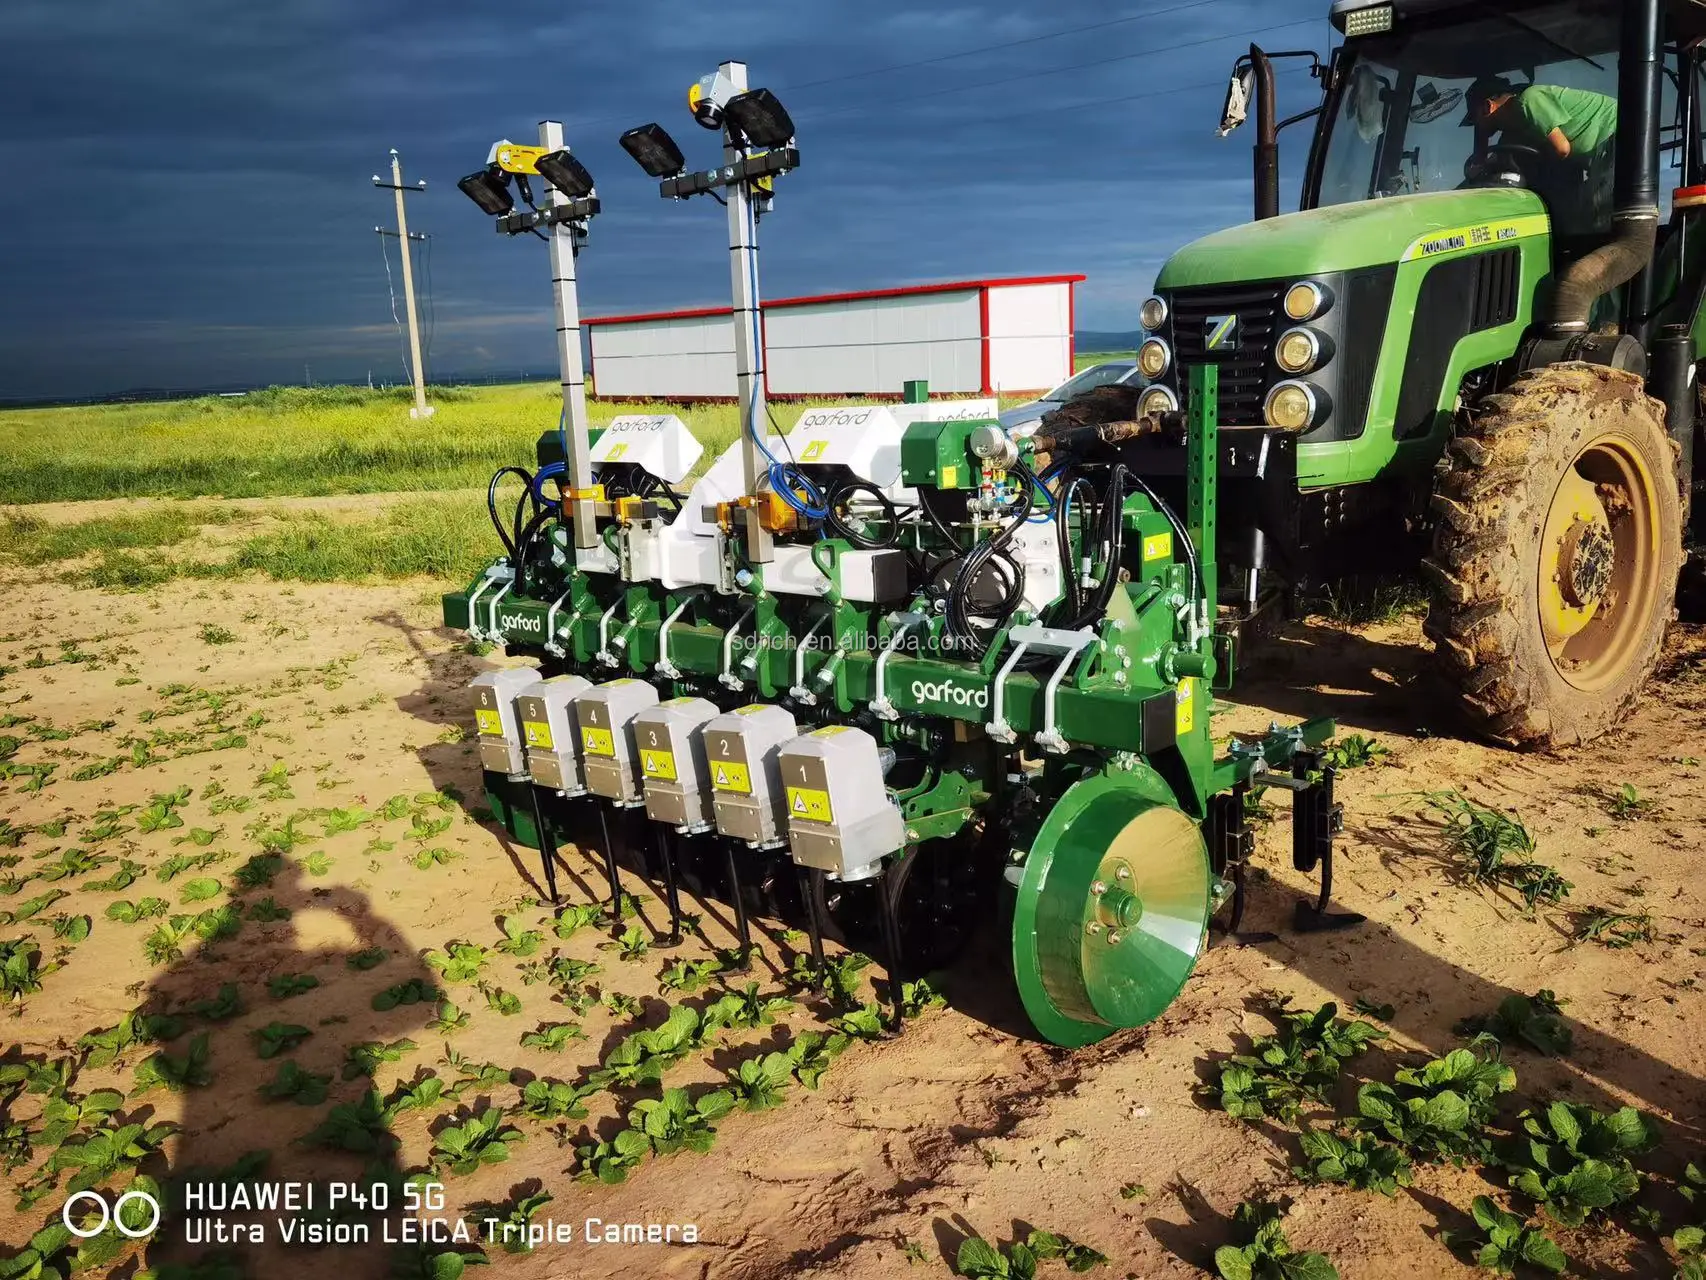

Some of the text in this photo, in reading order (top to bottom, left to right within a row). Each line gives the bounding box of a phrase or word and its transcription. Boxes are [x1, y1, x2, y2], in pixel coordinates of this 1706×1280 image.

[1420, 234, 1465, 256] ZOOMLION
[611, 417, 666, 435] garford
[803, 409, 872, 430] garford
[501, 612, 541, 633] garford
[480, 692, 488, 706] 6
[911, 679, 988, 709] garford
[529, 703, 537, 717] 5
[590, 709, 597, 724] 4
[649, 731, 658, 746] 3
[720, 739, 730, 756] 2
[799, 765, 807, 782] 1
